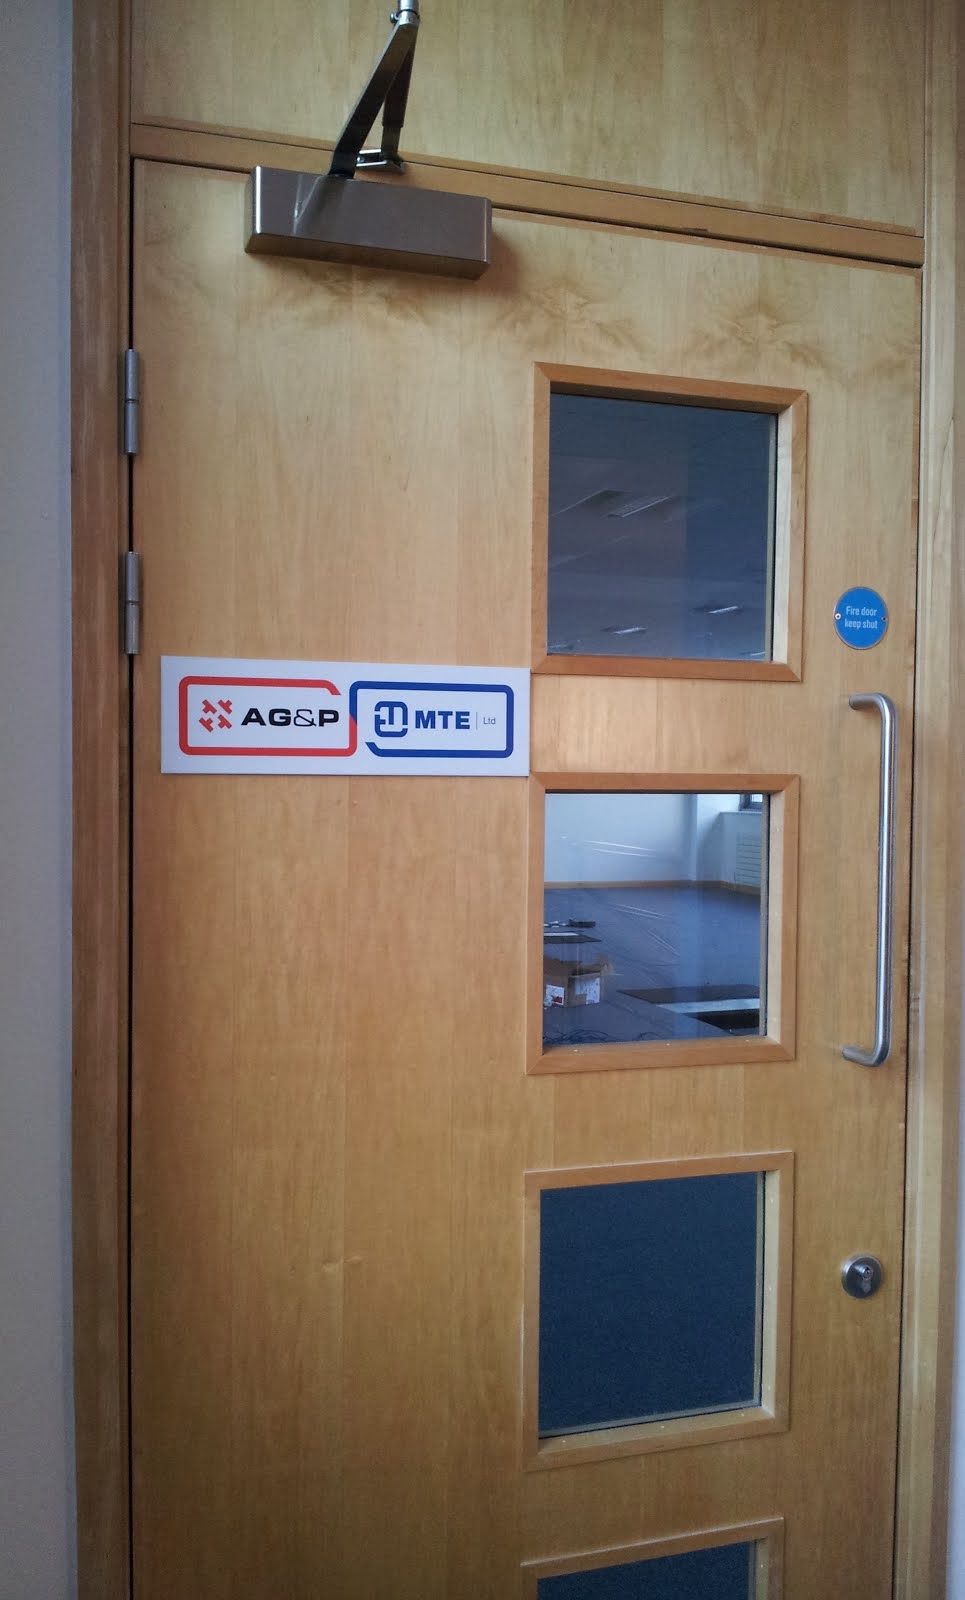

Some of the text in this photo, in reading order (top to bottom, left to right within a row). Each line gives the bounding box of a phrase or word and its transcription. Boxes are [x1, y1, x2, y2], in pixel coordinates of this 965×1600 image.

[846, 606, 877, 616] Fire door
[845, 619, 878, 630] keep shut
[241, 707, 340, 728] AG&P
[415, 710, 497, 730] MTE Ltd
